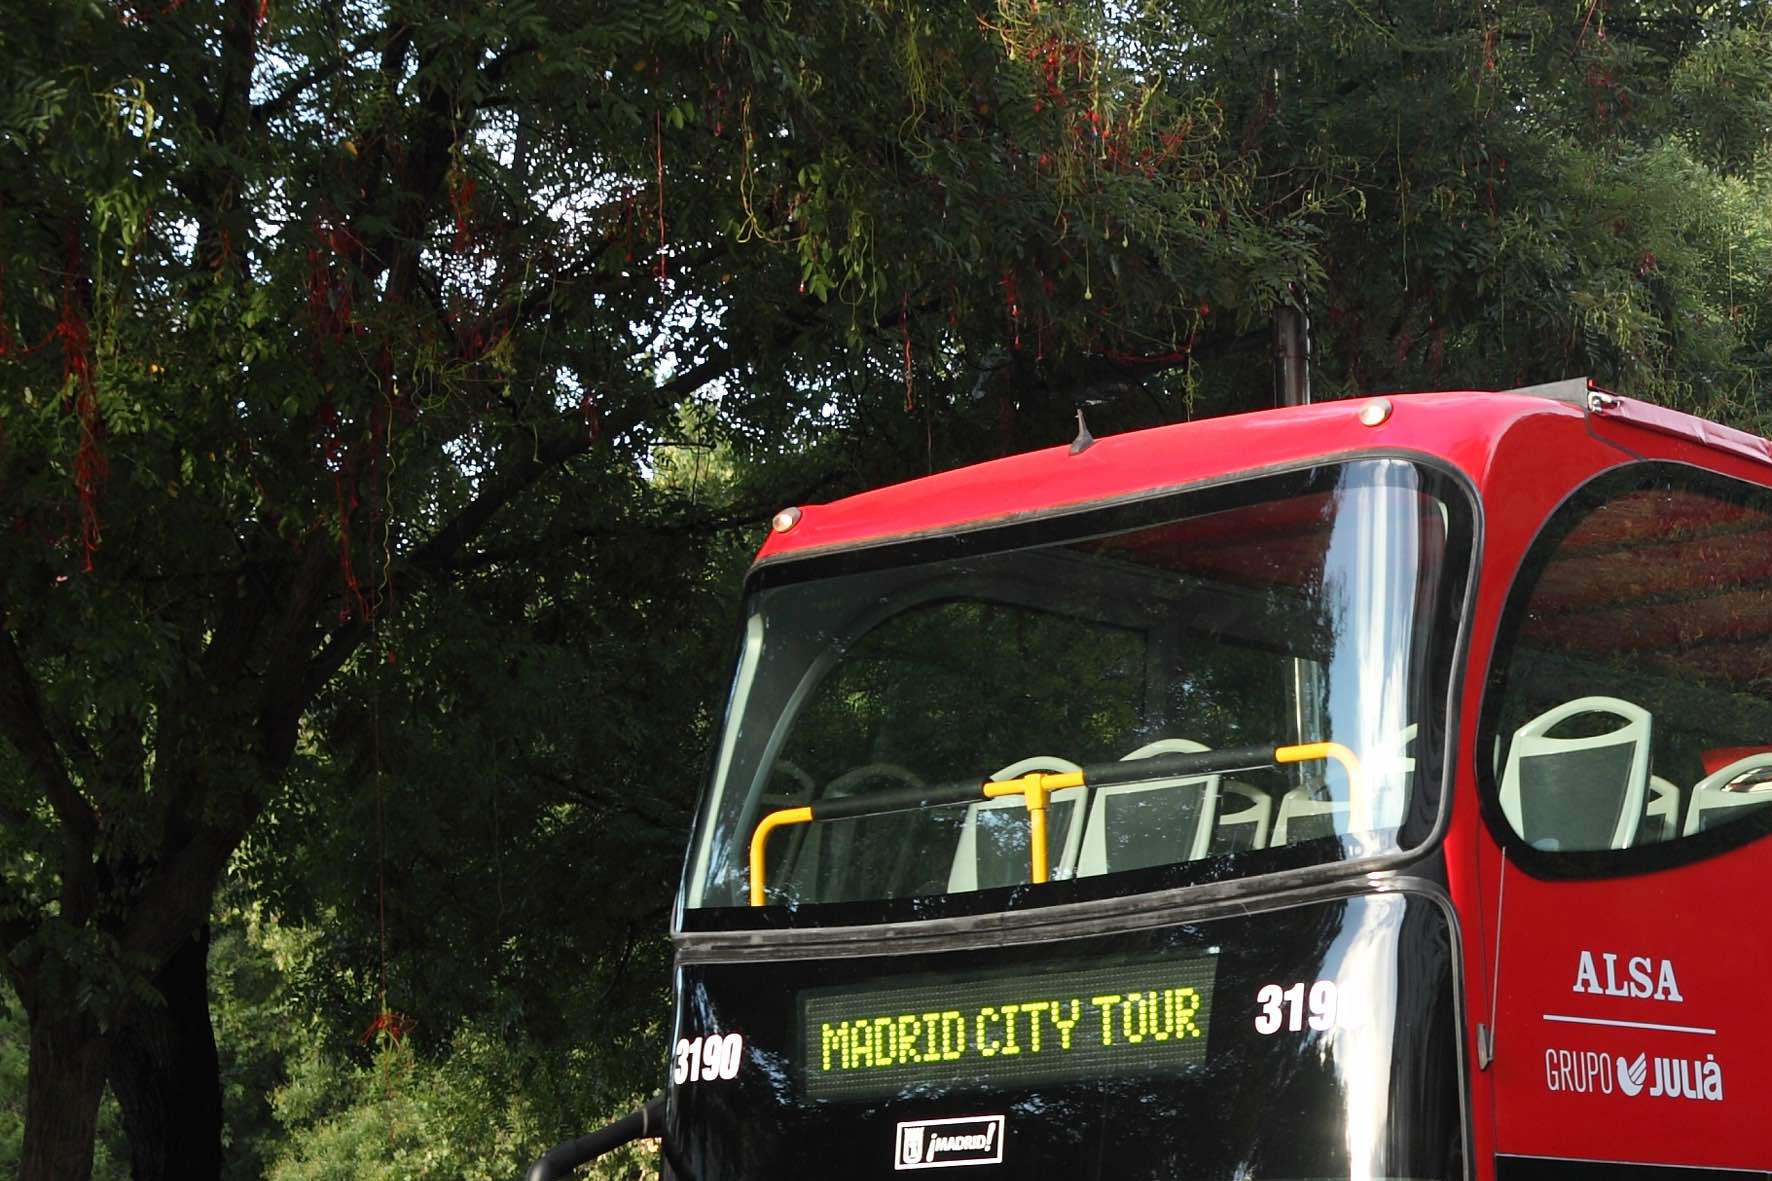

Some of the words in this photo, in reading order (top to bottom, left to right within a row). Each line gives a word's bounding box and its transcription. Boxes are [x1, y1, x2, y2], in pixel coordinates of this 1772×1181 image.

[1572, 950, 1684, 1002] ALSA
[821, 1010, 966, 1071] MADRID
[975, 998, 1080, 1057] CITY
[1091, 987, 1200, 1046] TOUR
[1254, 979, 1364, 1035] 319
[673, 1032, 743, 1085] 3190
[1544, 1048, 1613, 1095] GRUPO
